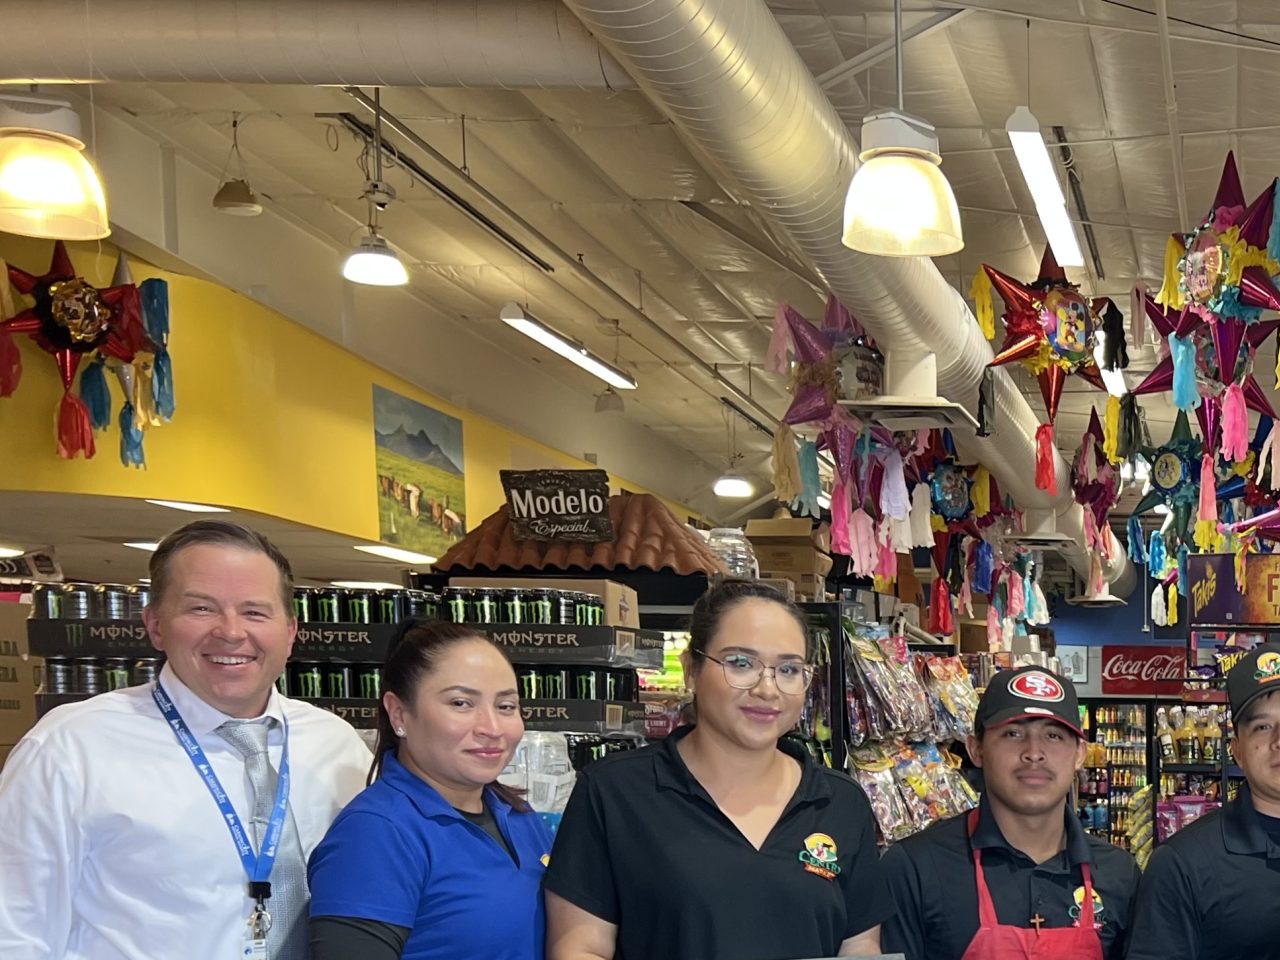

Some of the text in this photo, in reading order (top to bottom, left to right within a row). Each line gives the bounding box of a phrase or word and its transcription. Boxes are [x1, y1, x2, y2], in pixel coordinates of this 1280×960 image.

[510, 488, 604, 519] Modelo
[528, 518, 590, 538] Especial
[1191, 572, 1217, 618] Takis
[90, 624, 147, 641] MONS
[297, 628, 372, 644] ONSTER
[493, 630, 580, 647] MONSTER
[1102, 653, 1185, 681] Coca-Cola
